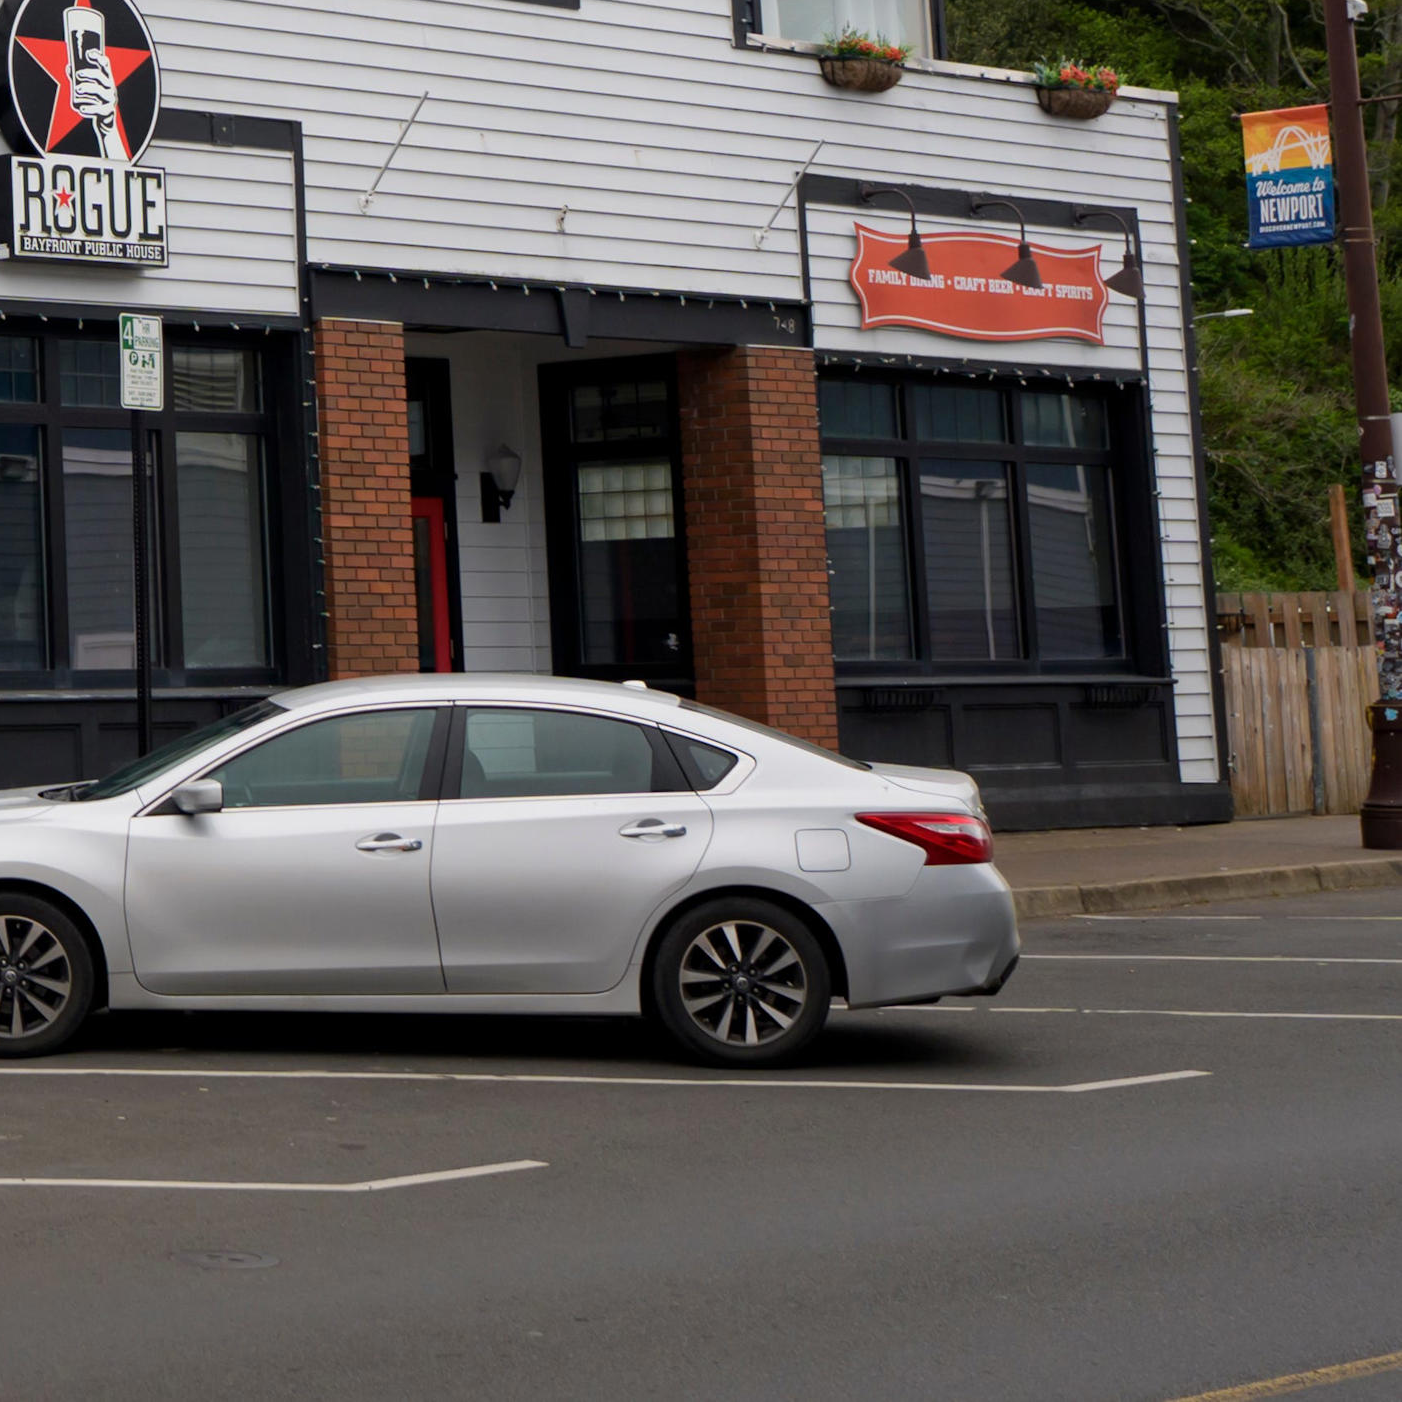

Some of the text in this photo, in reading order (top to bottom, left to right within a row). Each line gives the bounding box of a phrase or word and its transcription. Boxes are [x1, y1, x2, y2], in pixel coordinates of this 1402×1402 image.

[1256, 176, 1326, 197] Welcome to
[17, 161, 164, 242] ROGUE
[1260, 194, 1324, 223] NEWPORT
[23, 237, 162, 260] BAYFRONT PUBLIC HOUSE
[868, 269, 908, 286] FAMILY
[910, 274, 945, 289] DINING
[953, 276, 986, 292] CRAFT
[988, 278, 1014, 294] BEER
[1055, 284, 1093, 300] SPIRITS
[122, 321, 133, 345] 4
[134, 335, 159, 348] PARKING
